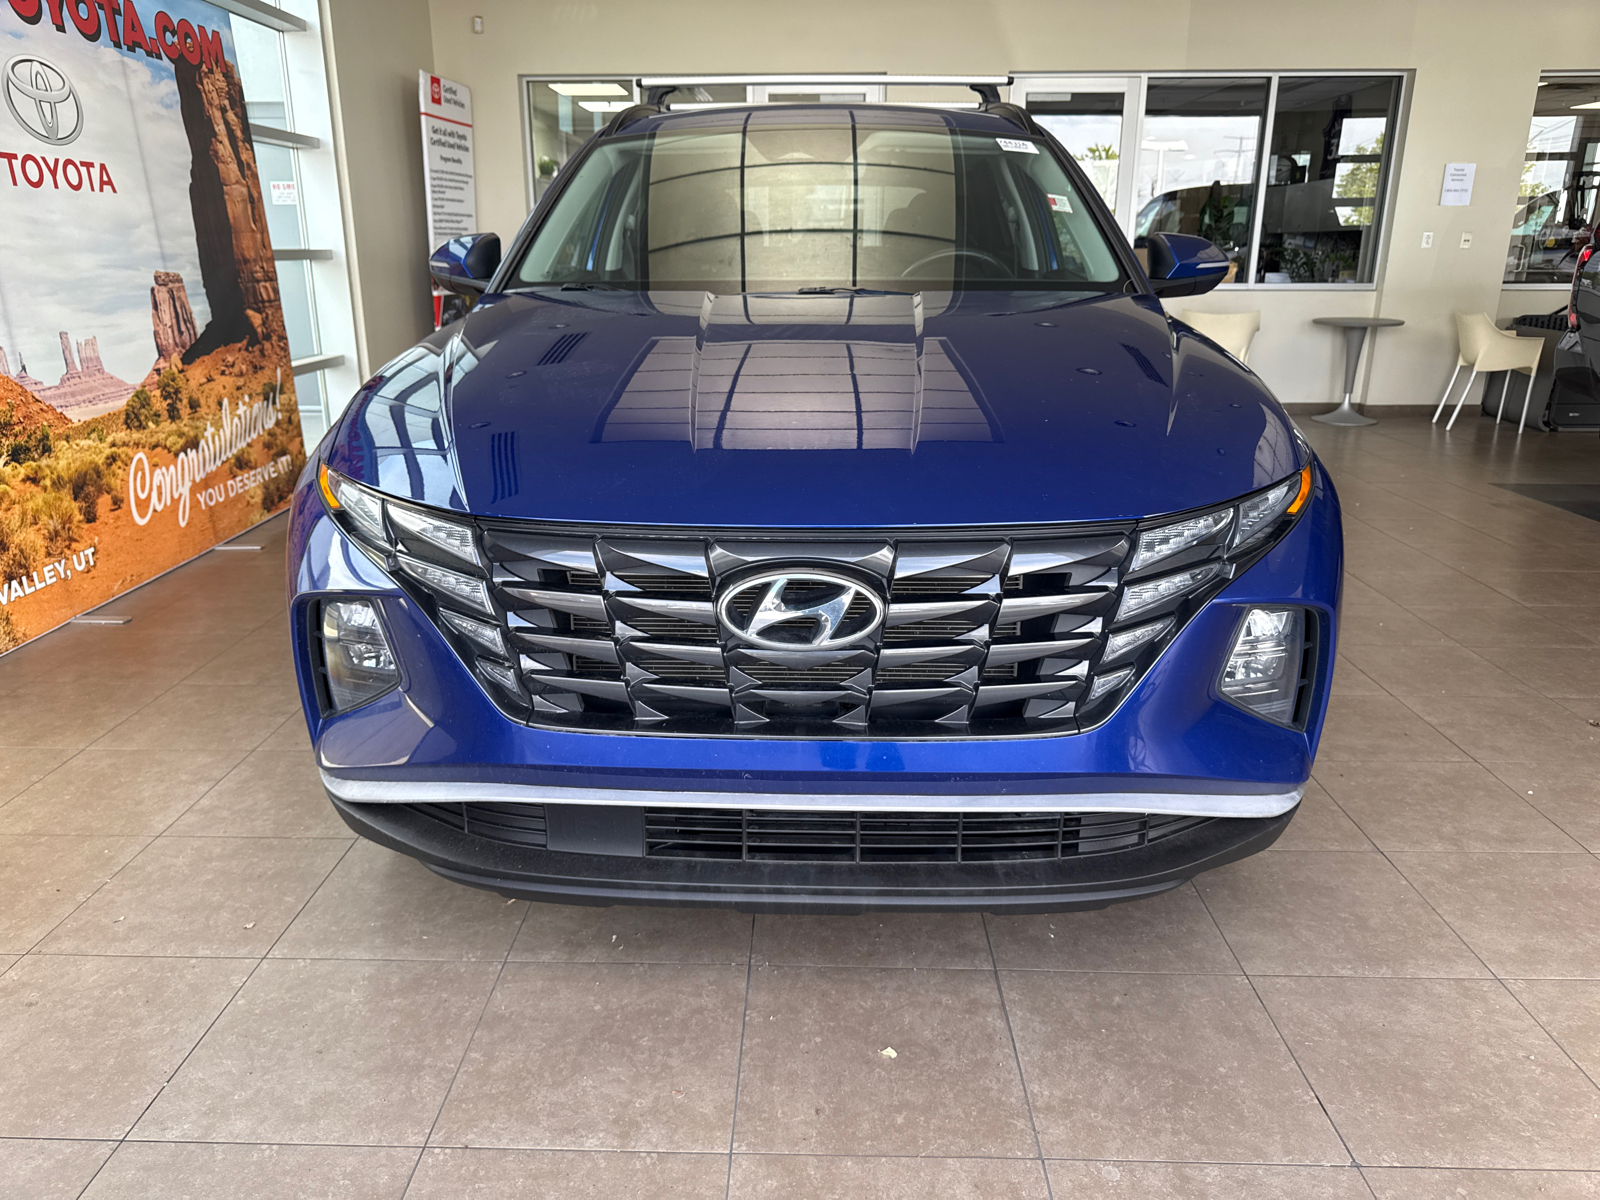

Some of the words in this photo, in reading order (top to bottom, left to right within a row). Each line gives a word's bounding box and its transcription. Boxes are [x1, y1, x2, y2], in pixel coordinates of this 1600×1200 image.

[0, 152, 118, 194] TOYOTA
[129, 367, 283, 527] Congratulations!
[196, 484, 225, 510] YOU
[226, 461, 278, 498] DESERVE
[276, 454, 293, 475] IT!
[72, 546, 95, 571] UT
